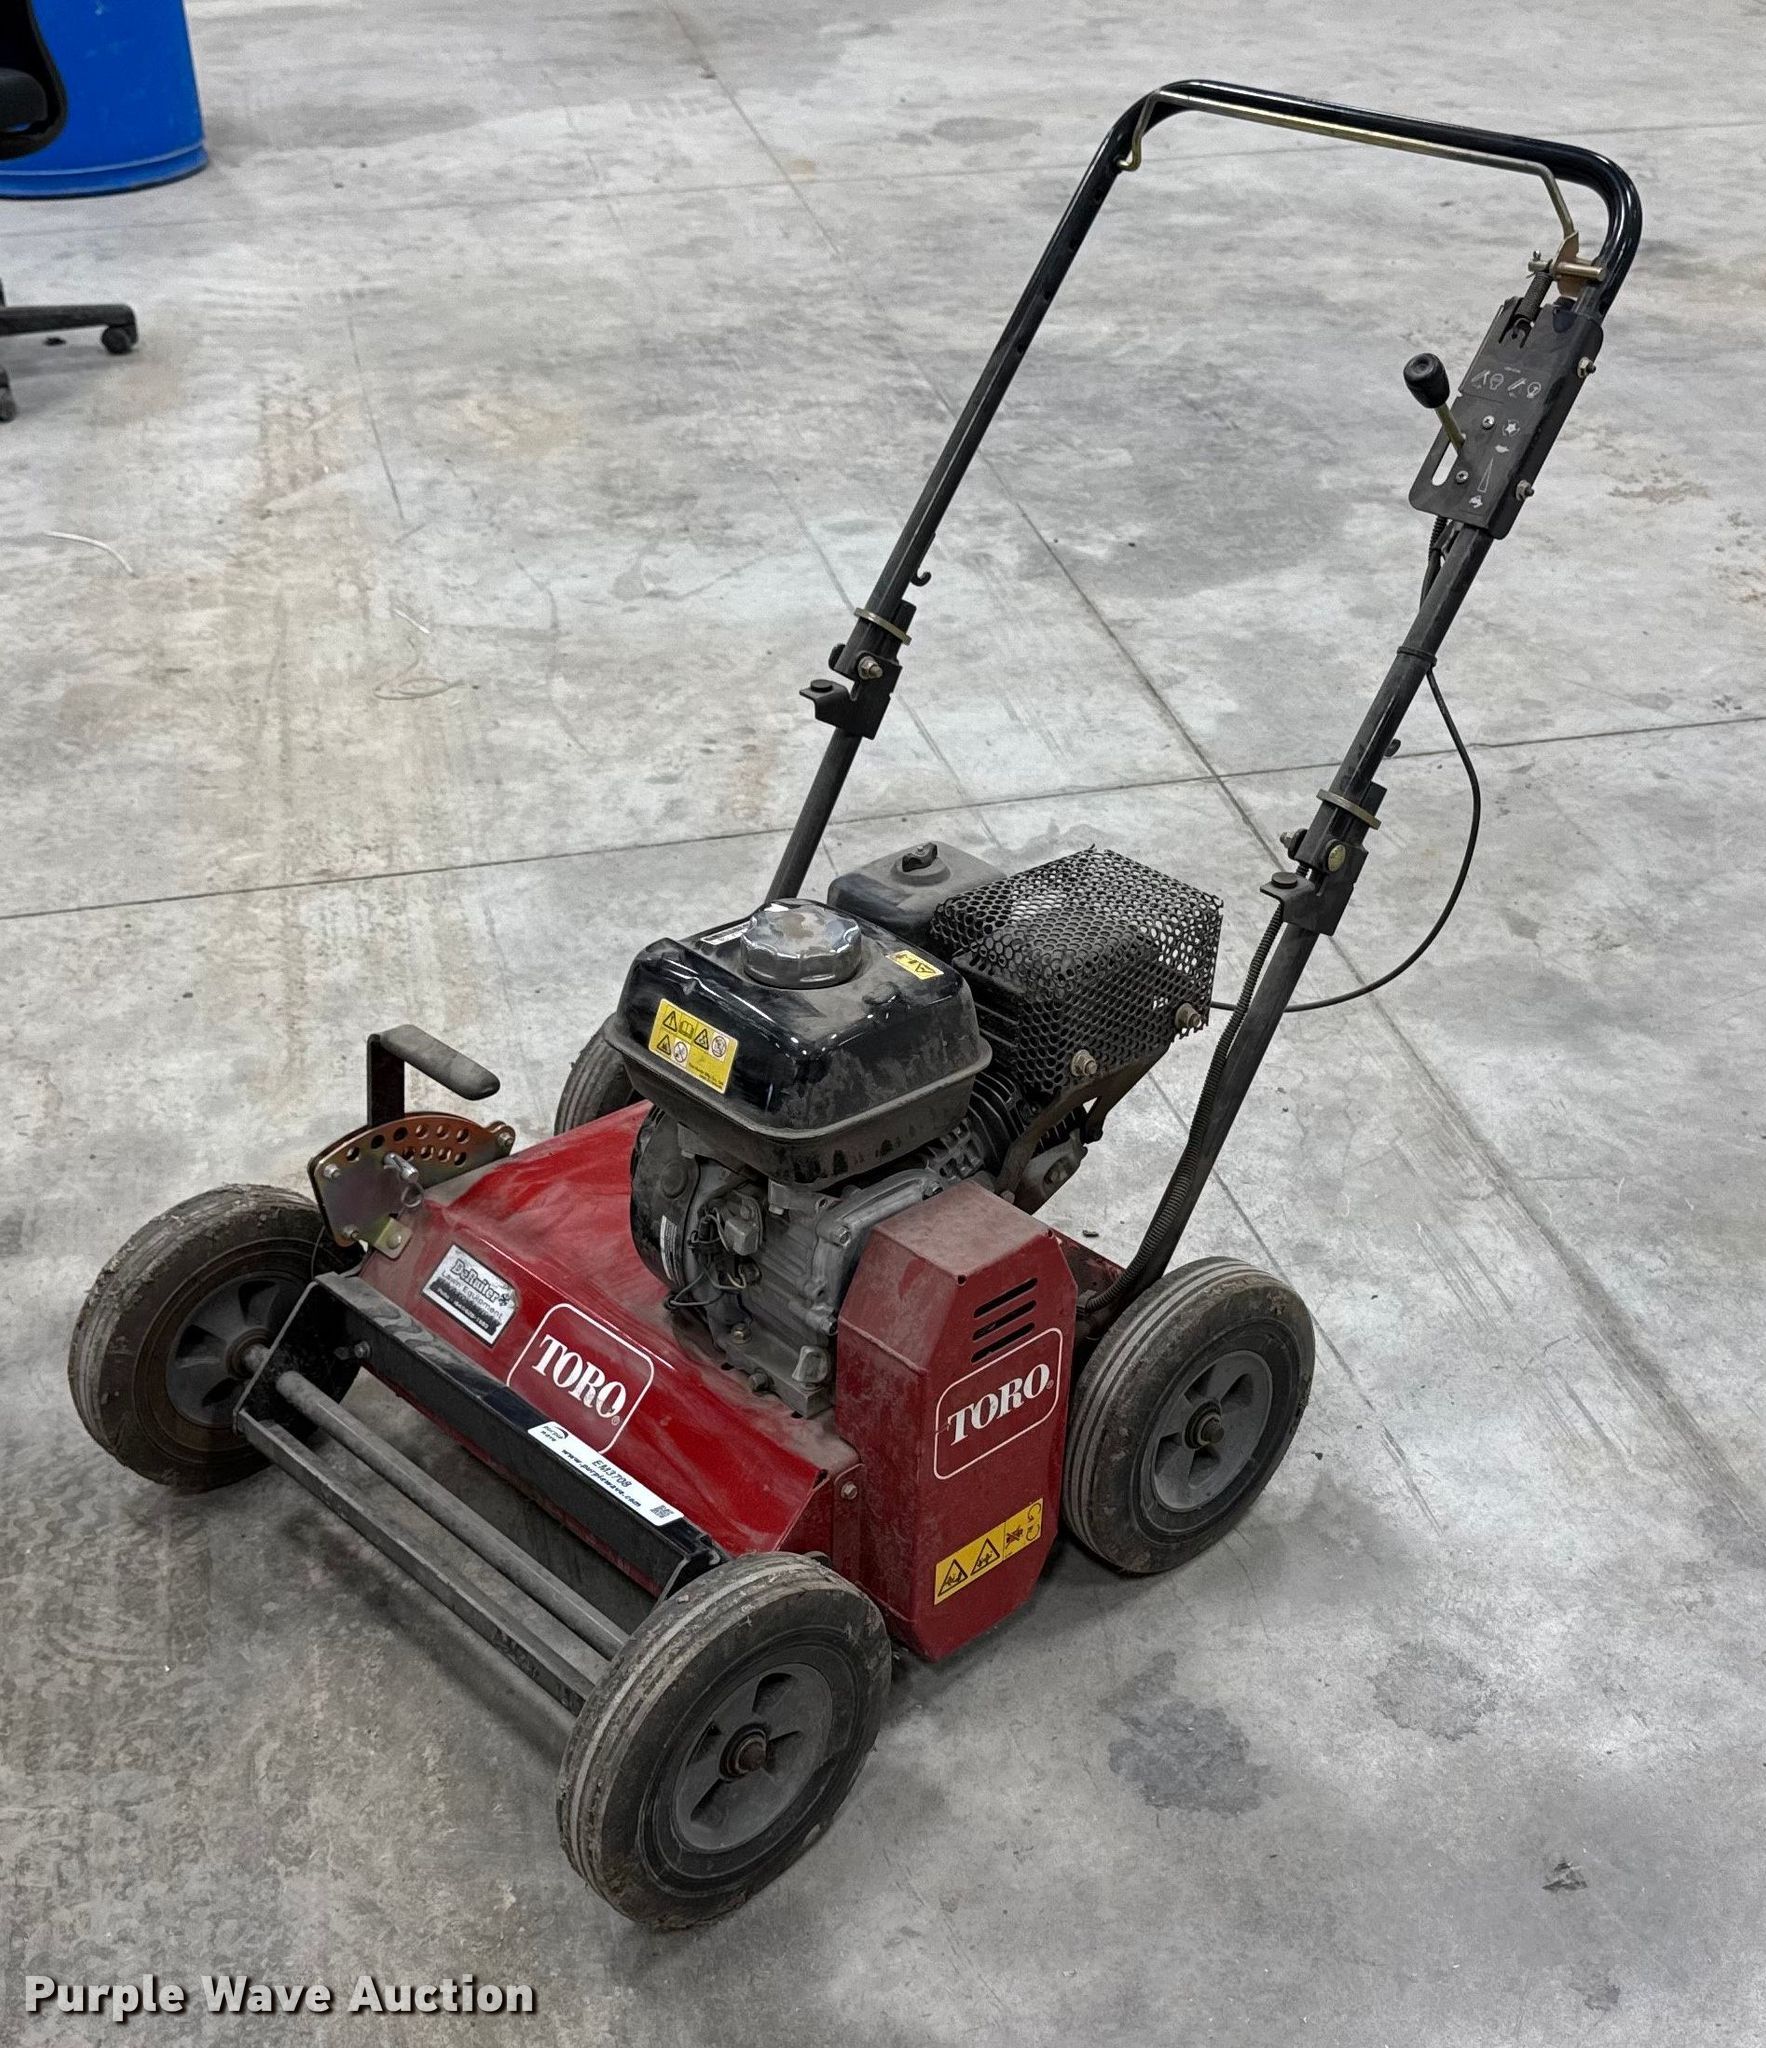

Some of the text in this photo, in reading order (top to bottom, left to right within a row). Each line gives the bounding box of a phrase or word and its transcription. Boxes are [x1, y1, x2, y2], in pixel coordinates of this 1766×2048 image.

[442, 1270, 462, 1288] Lawn
[462, 1286, 503, 1319] Equipment
[450, 1258, 500, 1303] DeRuiter
[532, 1334, 627, 1419] TORO
[947, 1363, 1051, 1446] TORO
[561, 1449, 642, 1508] www.purplewave.com
[592, 1459, 633, 1488] EM3708
